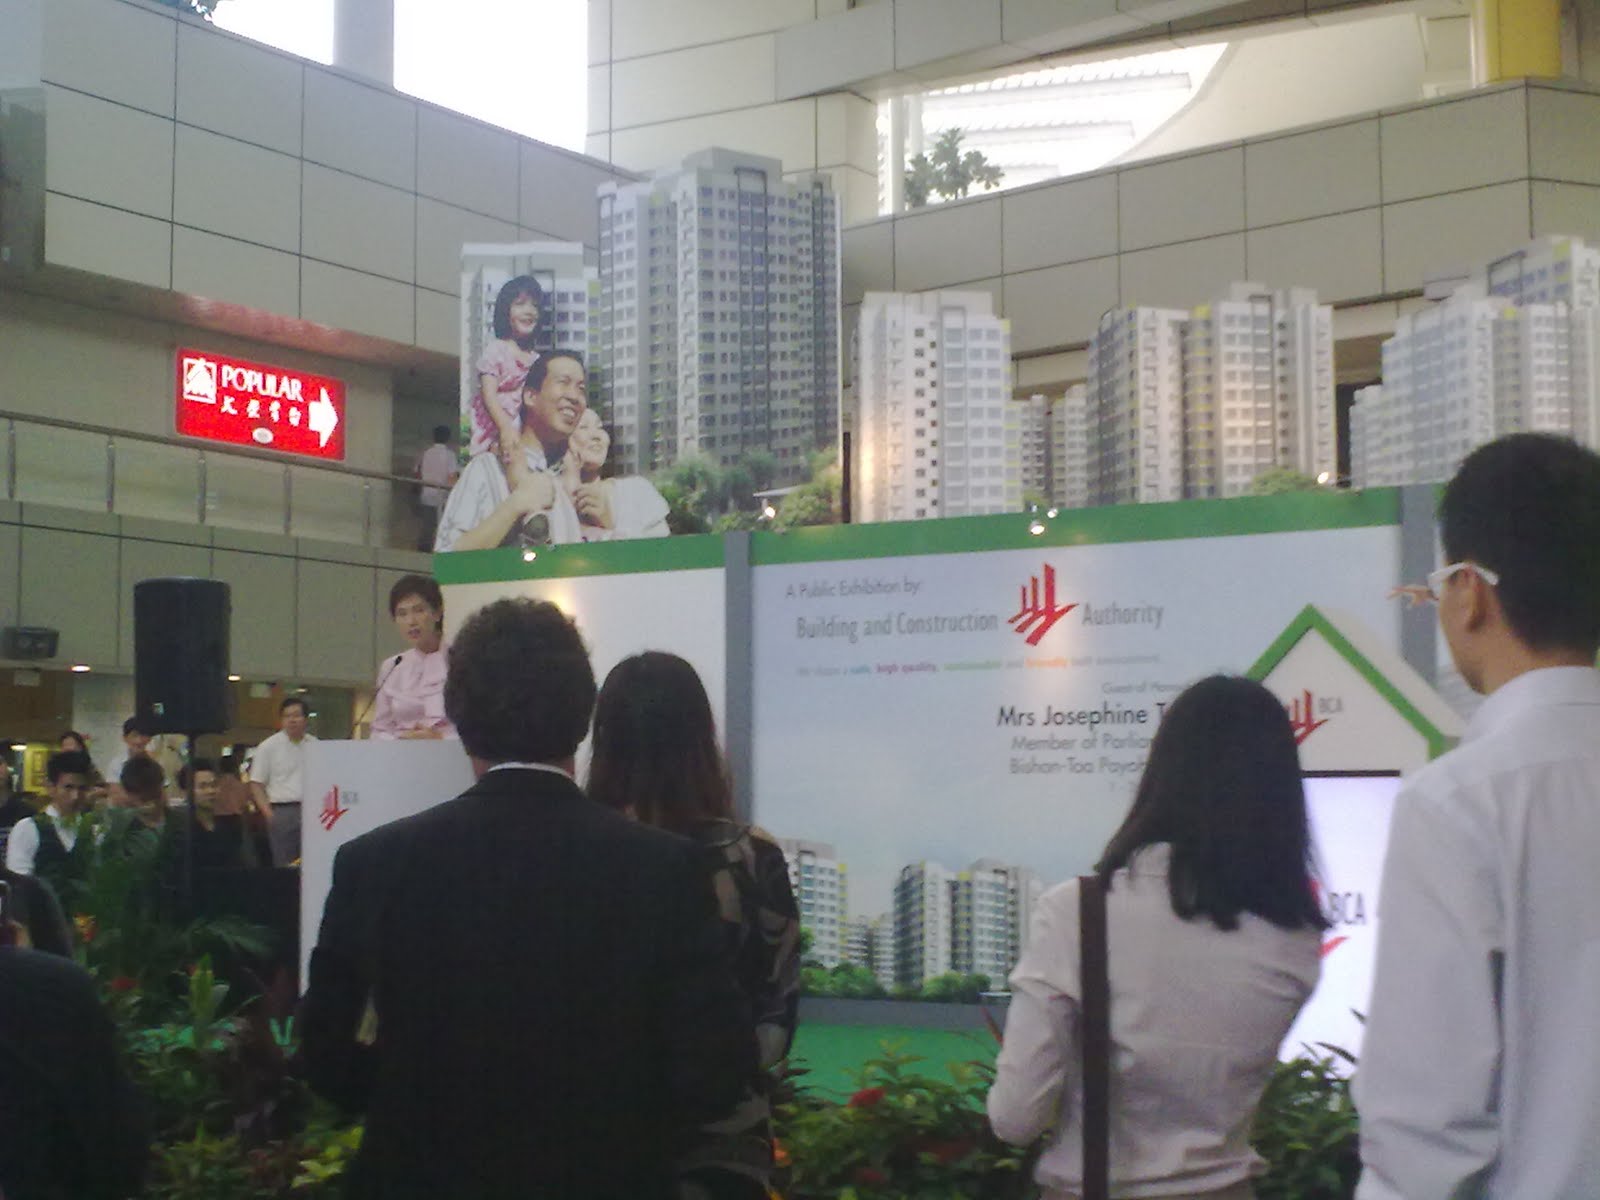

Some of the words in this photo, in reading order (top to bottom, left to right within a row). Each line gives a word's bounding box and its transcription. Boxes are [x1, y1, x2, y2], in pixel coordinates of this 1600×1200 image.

[221, 364, 304, 402] POPULAR
[800, 579, 836, 598] Public
[839, 577, 900, 596] Exhibition
[796, 615, 859, 644] Building
[864, 613, 893, 637] and
[896, 611, 999, 635] Construction
[1082, 601, 1164, 630] Authority
[997, 705, 1036, 728] Mrs
[1042, 700, 1148, 732] Josephine
[1011, 733, 1076, 751] Member
[1081, 732, 1099, 750] of
[1103, 731, 1152, 751] Parlia
[1327, 892, 1367, 926] BCA
